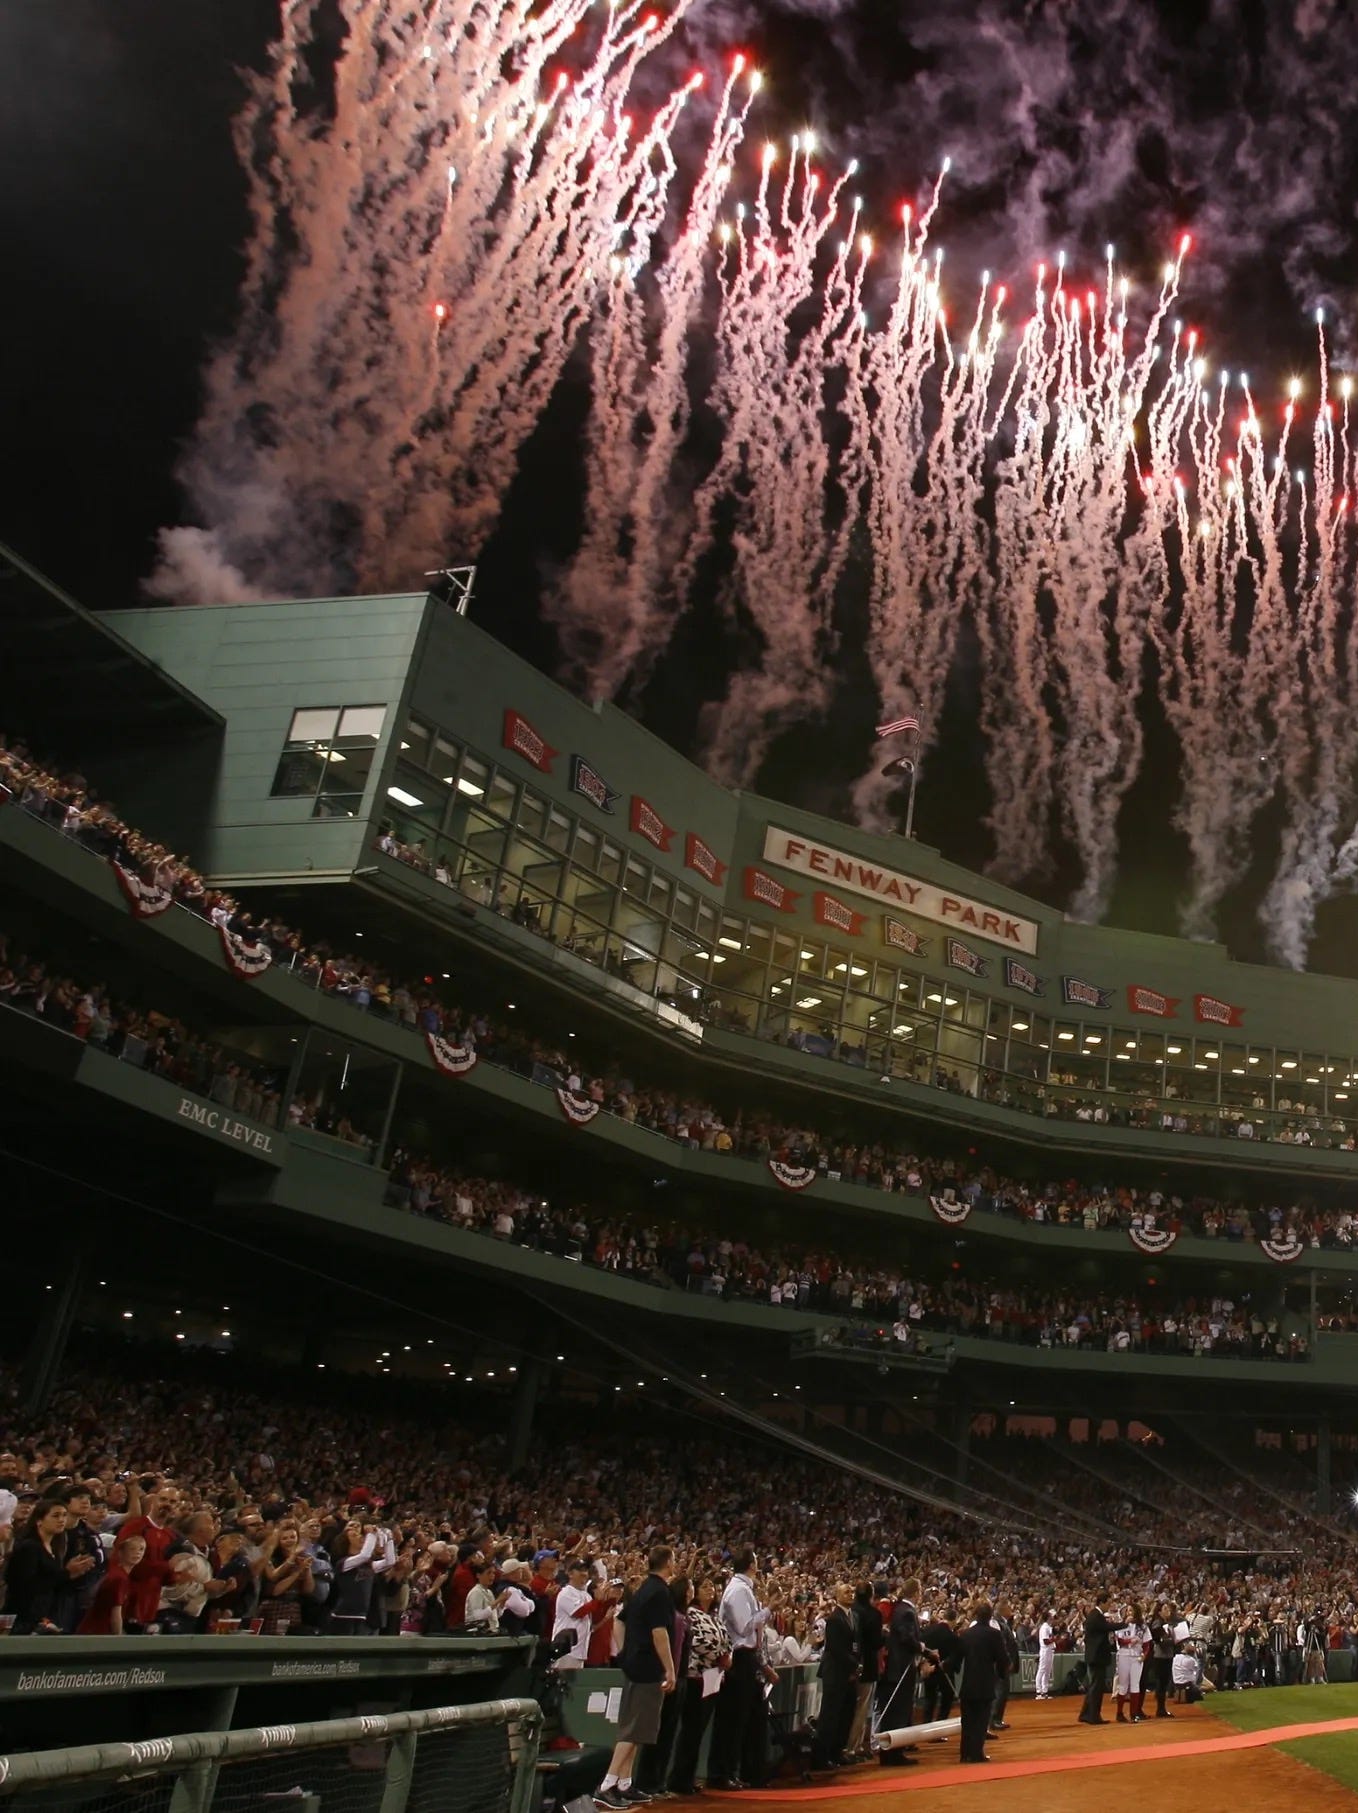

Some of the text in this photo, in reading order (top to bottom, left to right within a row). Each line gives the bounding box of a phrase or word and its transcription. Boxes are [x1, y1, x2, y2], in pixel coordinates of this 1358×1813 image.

[785, 840, 922, 904] FENWAY
[941, 896, 1020, 942] PARK
[178, 1098, 273, 1153] EMC LEVEL
